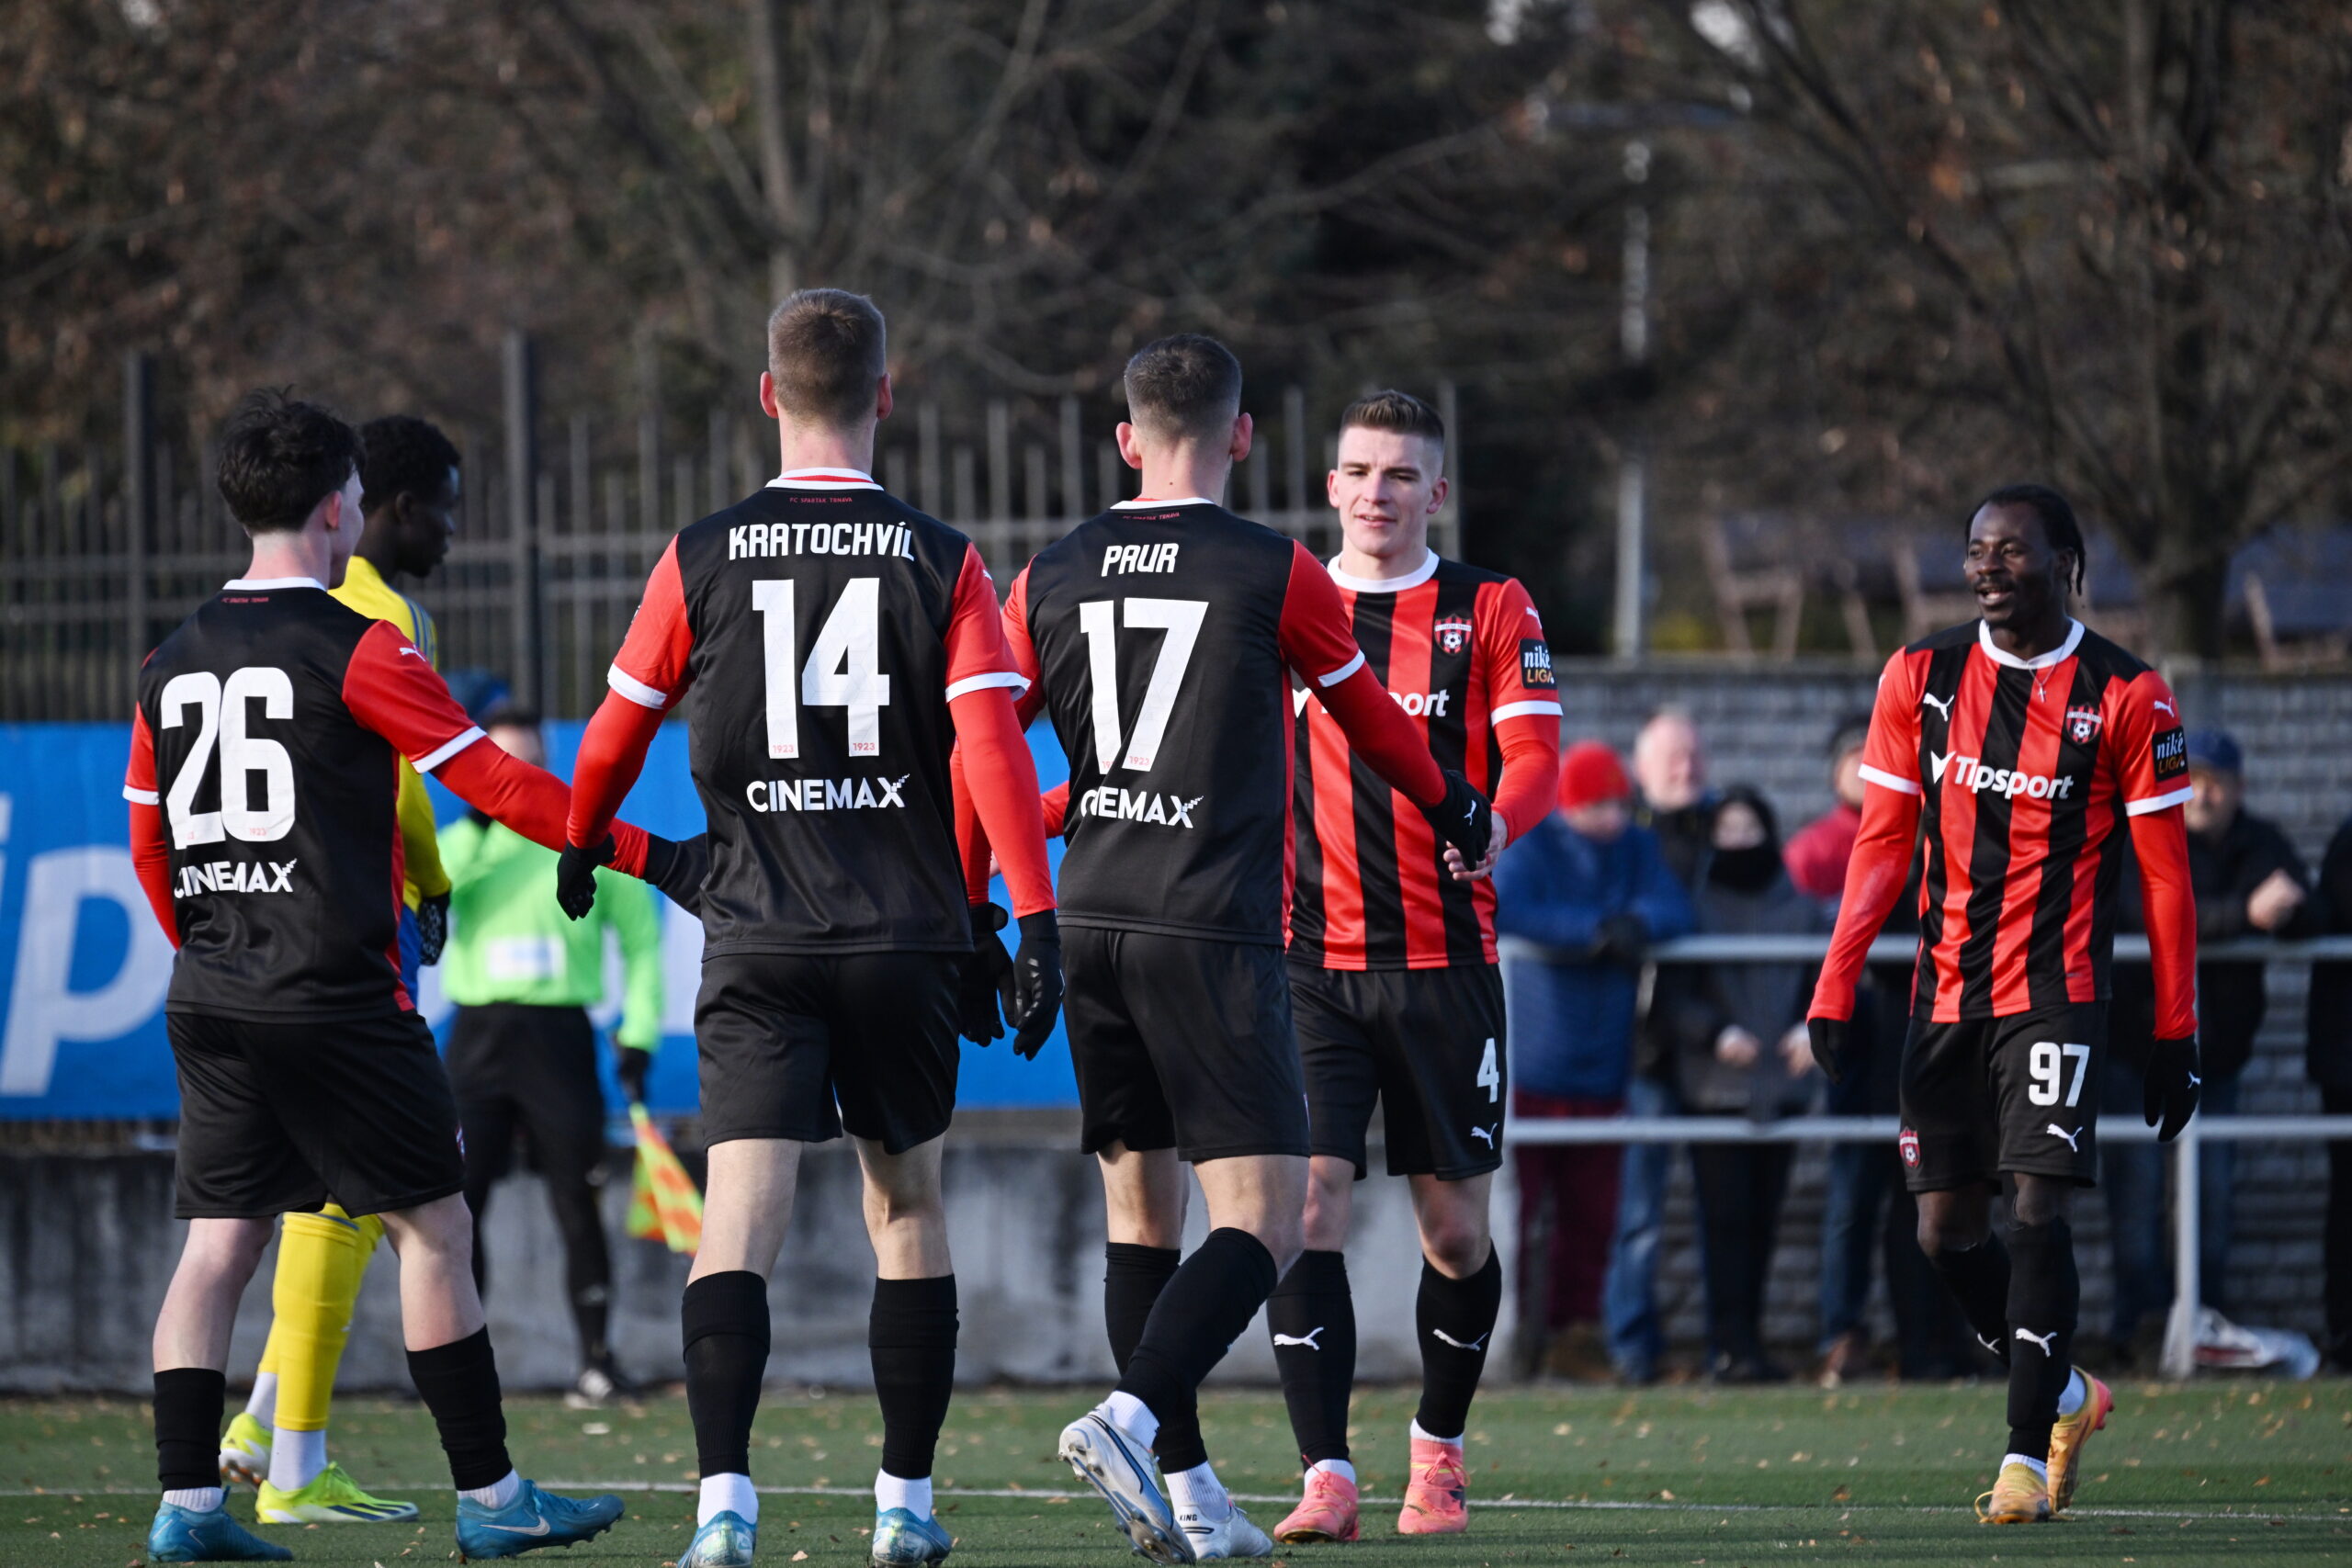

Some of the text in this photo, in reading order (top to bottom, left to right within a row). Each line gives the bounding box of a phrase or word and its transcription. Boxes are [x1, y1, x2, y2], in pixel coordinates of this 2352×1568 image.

[729, 521, 915, 561] KRATOCHVÍL
[1101, 543, 1180, 578] PAUR
[752, 577, 890, 760] 14
[1080, 597, 1209, 775] 17
[161, 667, 295, 851] 26
[773, 744, 795, 753] 1923
[853, 742, 876, 751] 1923
[1129, 755, 1150, 766] 1923
[2156, 732, 2185, 761] niké
[746, 773, 910, 813] CINEMAX
[1954, 755, 2074, 800] Tipsport
[1080, 785, 1204, 829] CEMAX
[1476, 1037, 1499, 1103] 4
[2029, 1042, 2090, 1108] 97
[1179, 1514, 1198, 1522] KING
